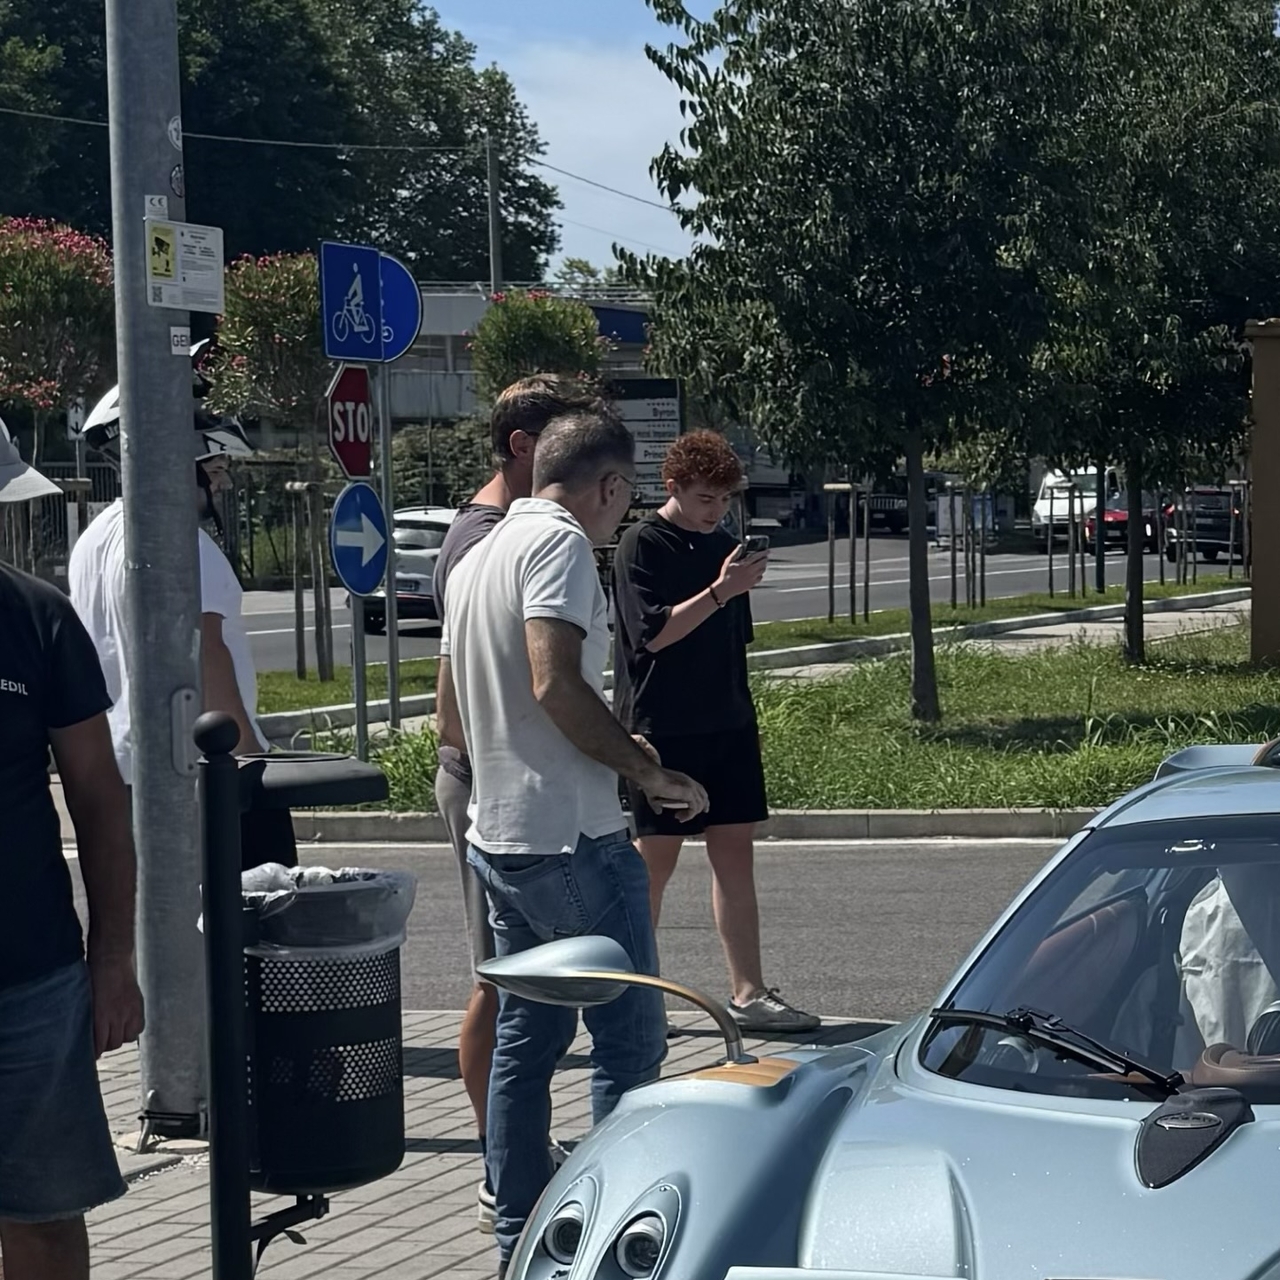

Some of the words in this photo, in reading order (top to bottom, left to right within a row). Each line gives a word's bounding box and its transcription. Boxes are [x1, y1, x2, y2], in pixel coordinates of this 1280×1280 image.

[652, 407, 677, 420] Byron
[333, 401, 373, 443] STO
[644, 450, 668, 459] Princi
